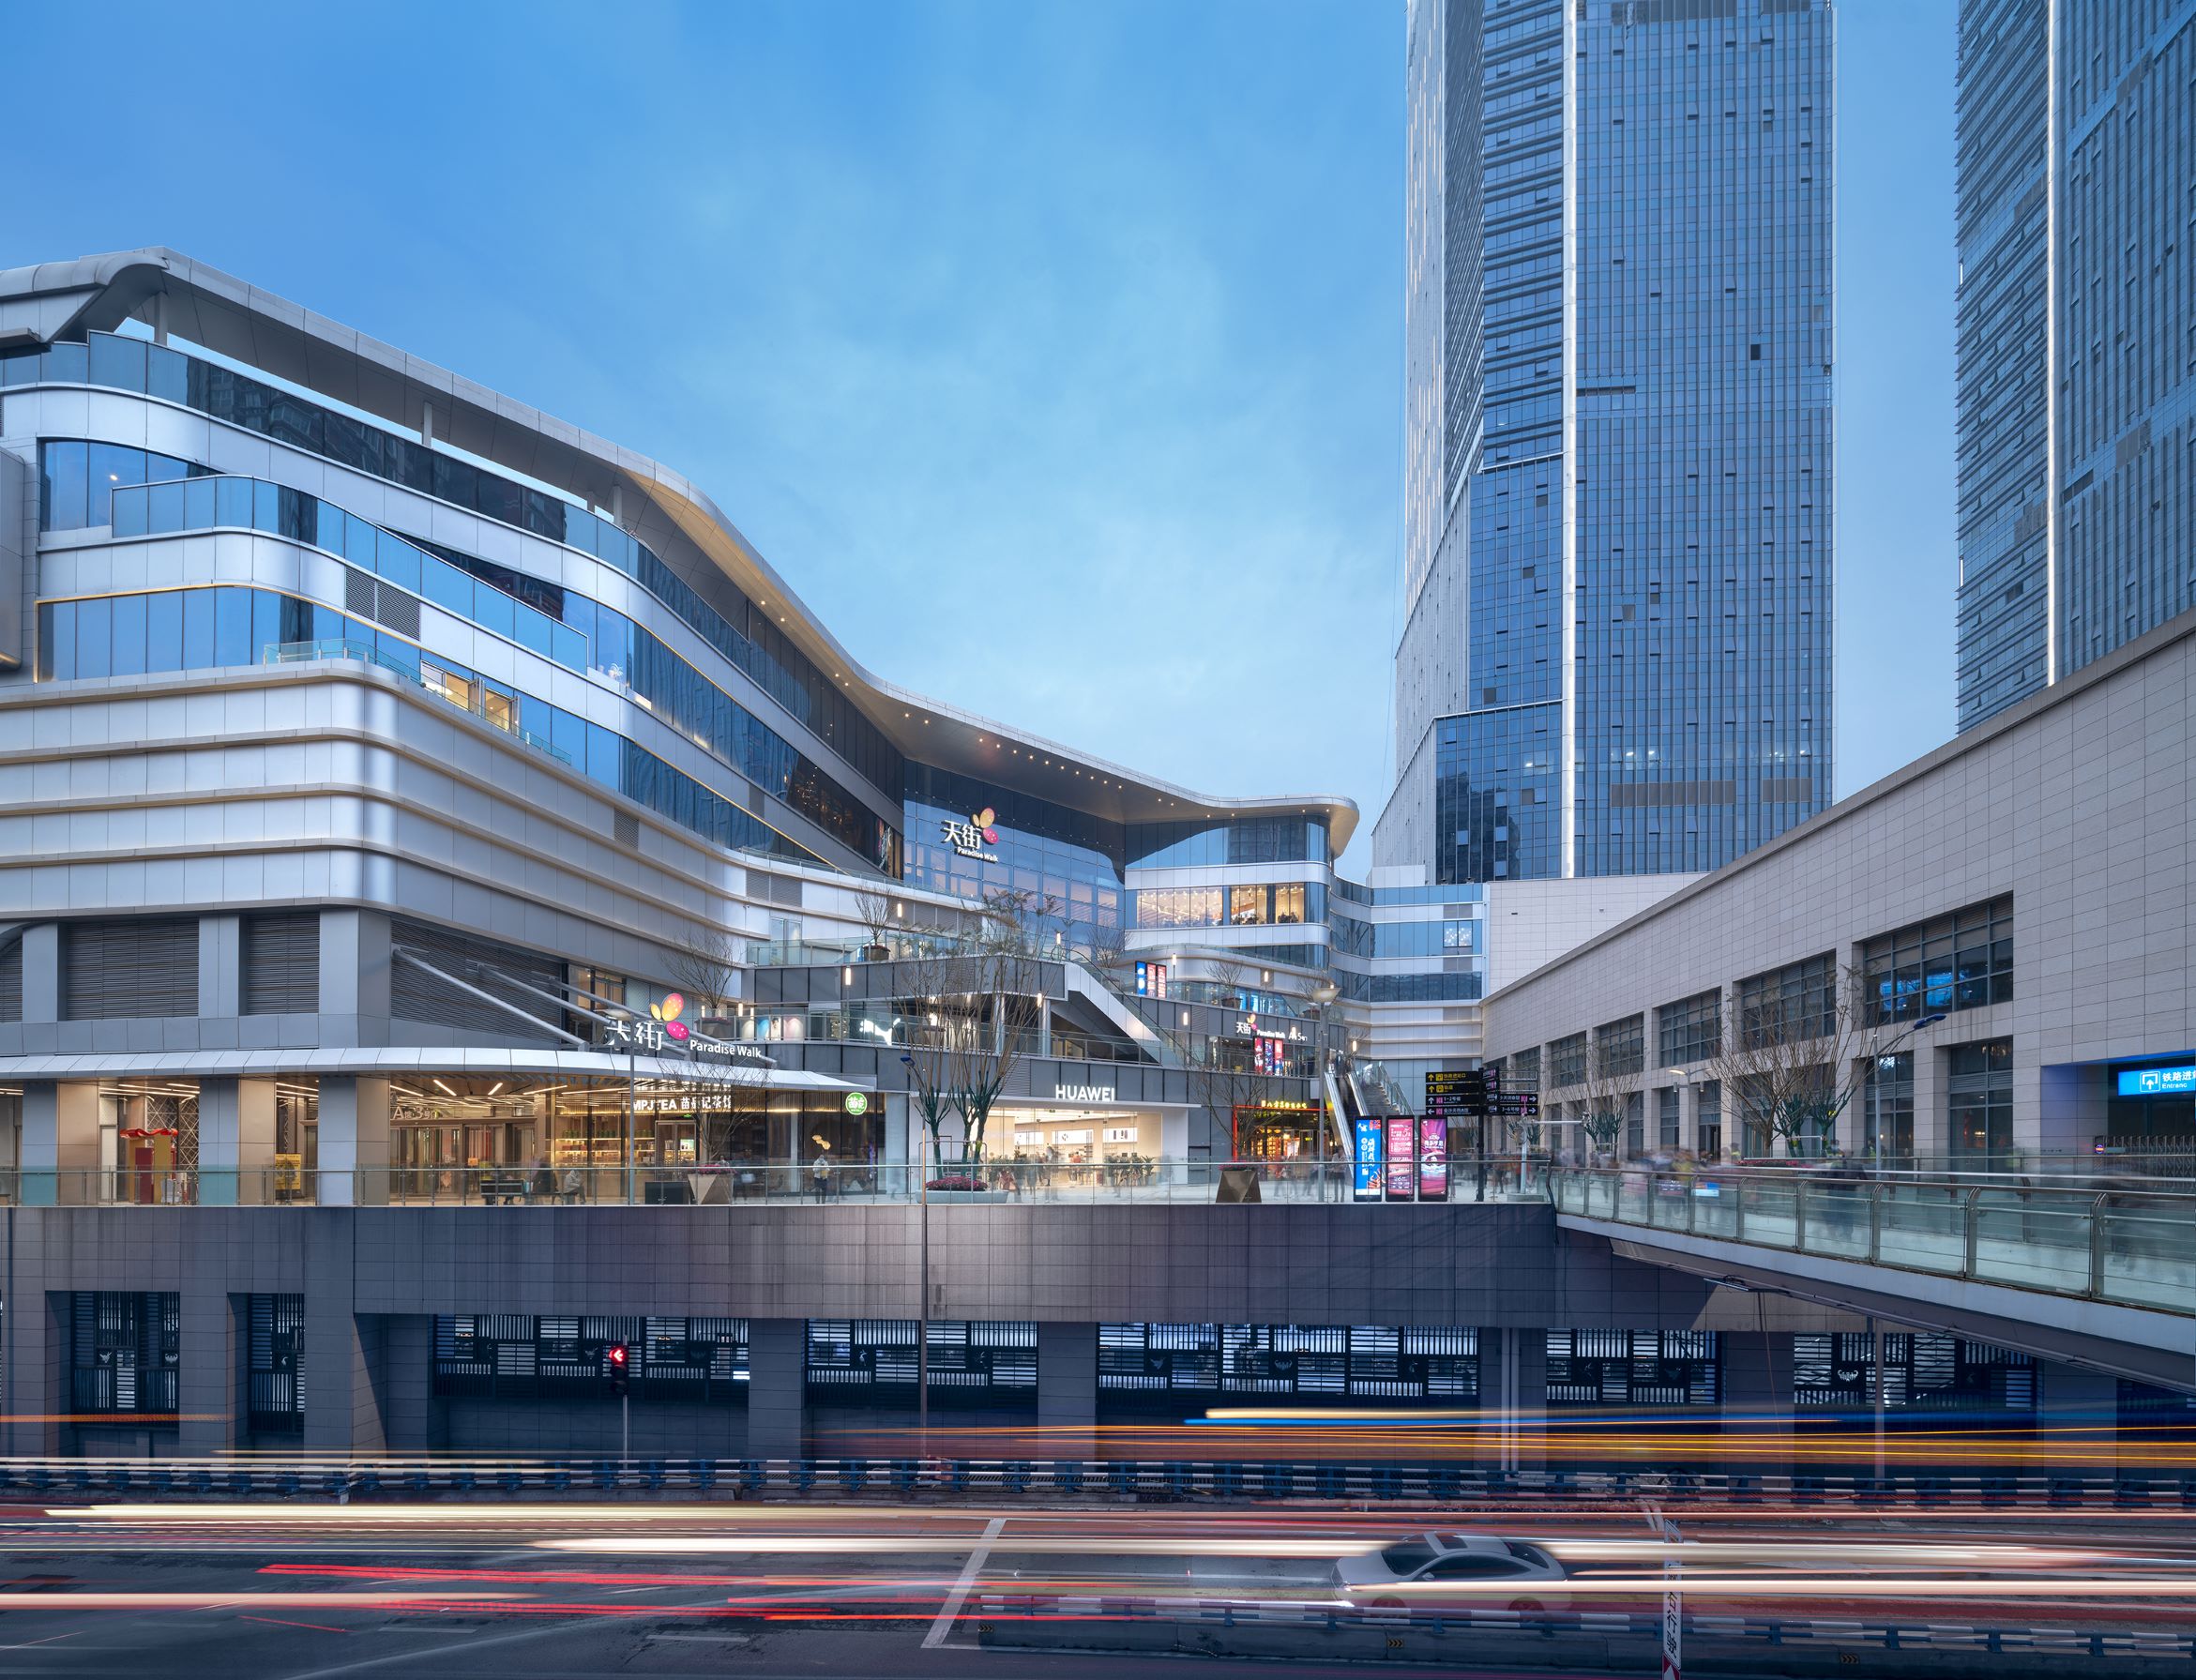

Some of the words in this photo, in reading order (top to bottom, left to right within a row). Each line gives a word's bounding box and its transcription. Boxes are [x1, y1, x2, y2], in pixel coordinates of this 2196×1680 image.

[944, 819, 981, 849] 天街
[957, 846, 984, 859] Paradise
[984, 852, 999, 863] Walk
[1235, 1022, 1251, 1035] 天街
[690, 1039, 735, 1055] Paradise
[737, 1045, 762, 1058] Walk
[1055, 1084, 1114, 1101] HUAWEI
